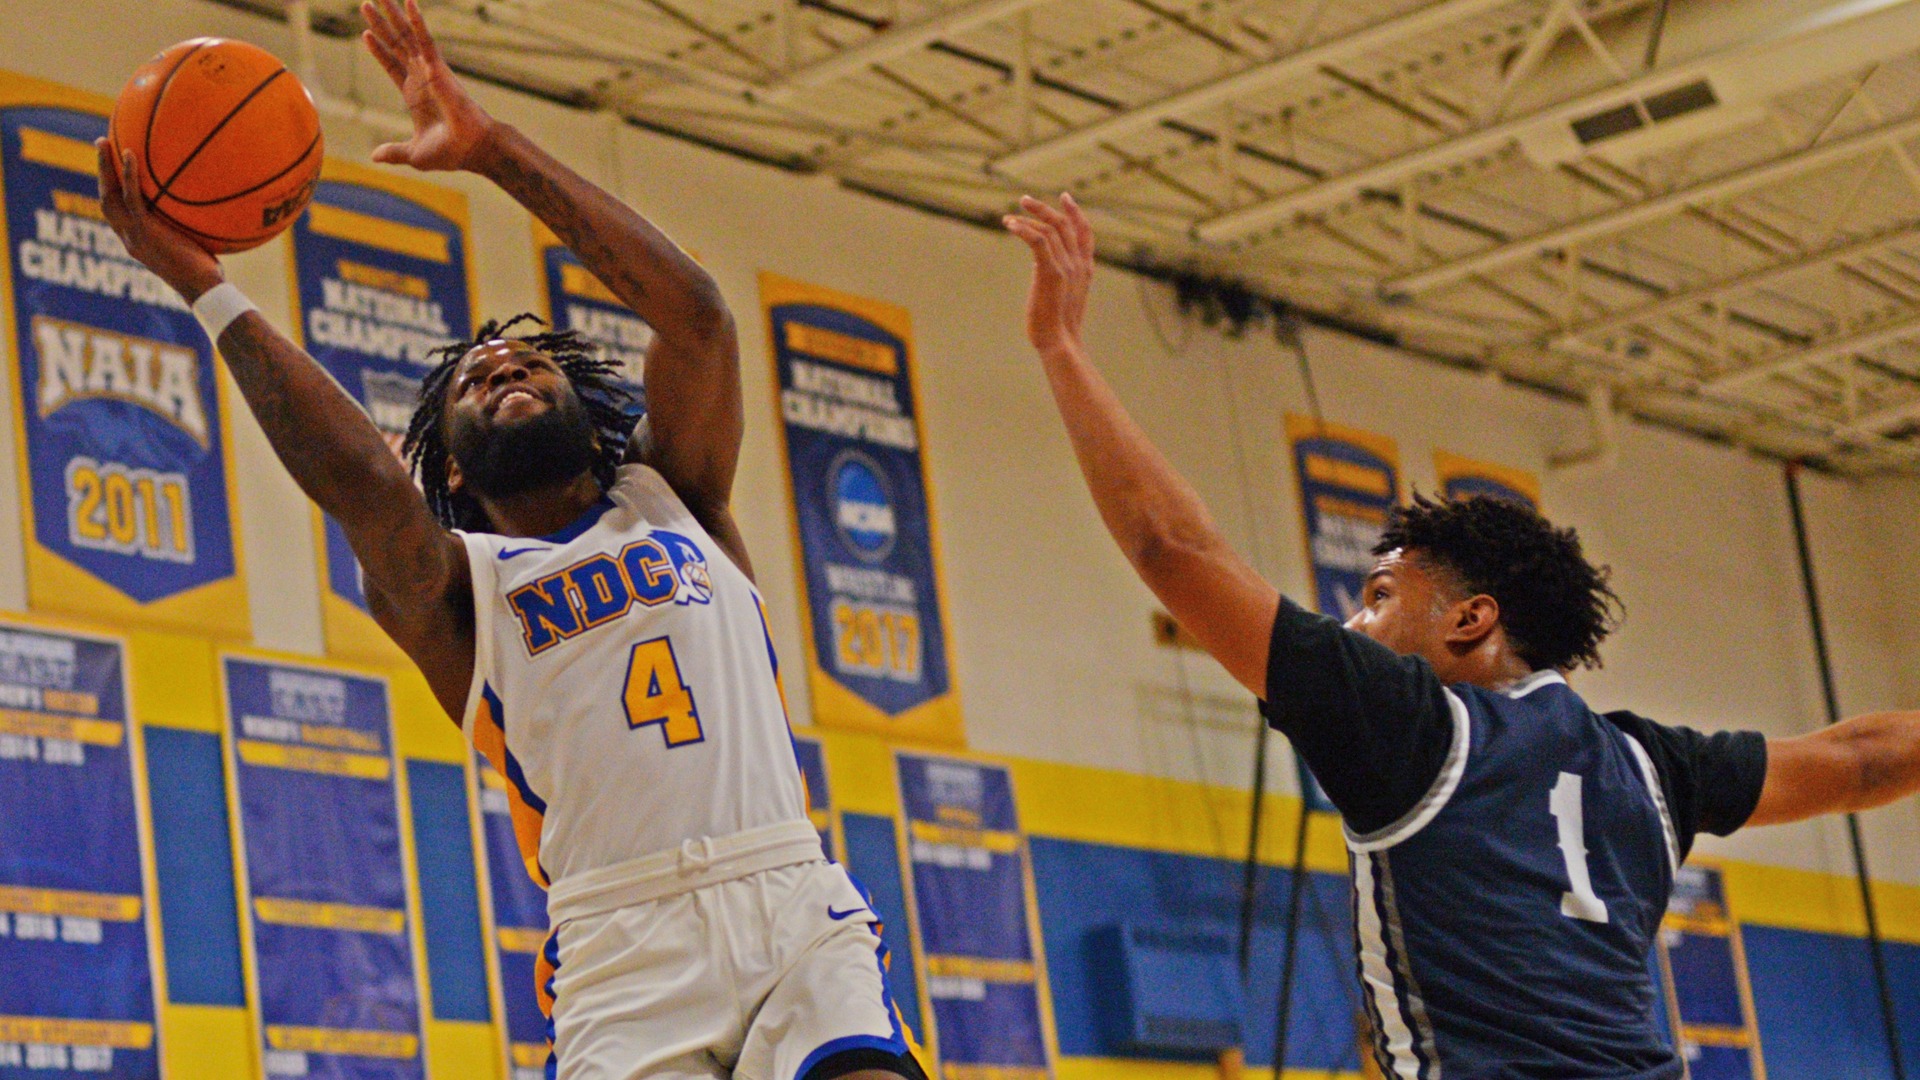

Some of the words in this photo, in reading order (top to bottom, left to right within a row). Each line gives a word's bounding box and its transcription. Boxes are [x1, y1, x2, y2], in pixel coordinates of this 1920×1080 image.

[34, 317, 208, 446] NAIA
[67, 458, 194, 562] 2011
[506, 538, 679, 656] NDC
[832, 599, 923, 682] 2017
[620, 634, 705, 749] 4
[1549, 770, 1609, 924] 1
